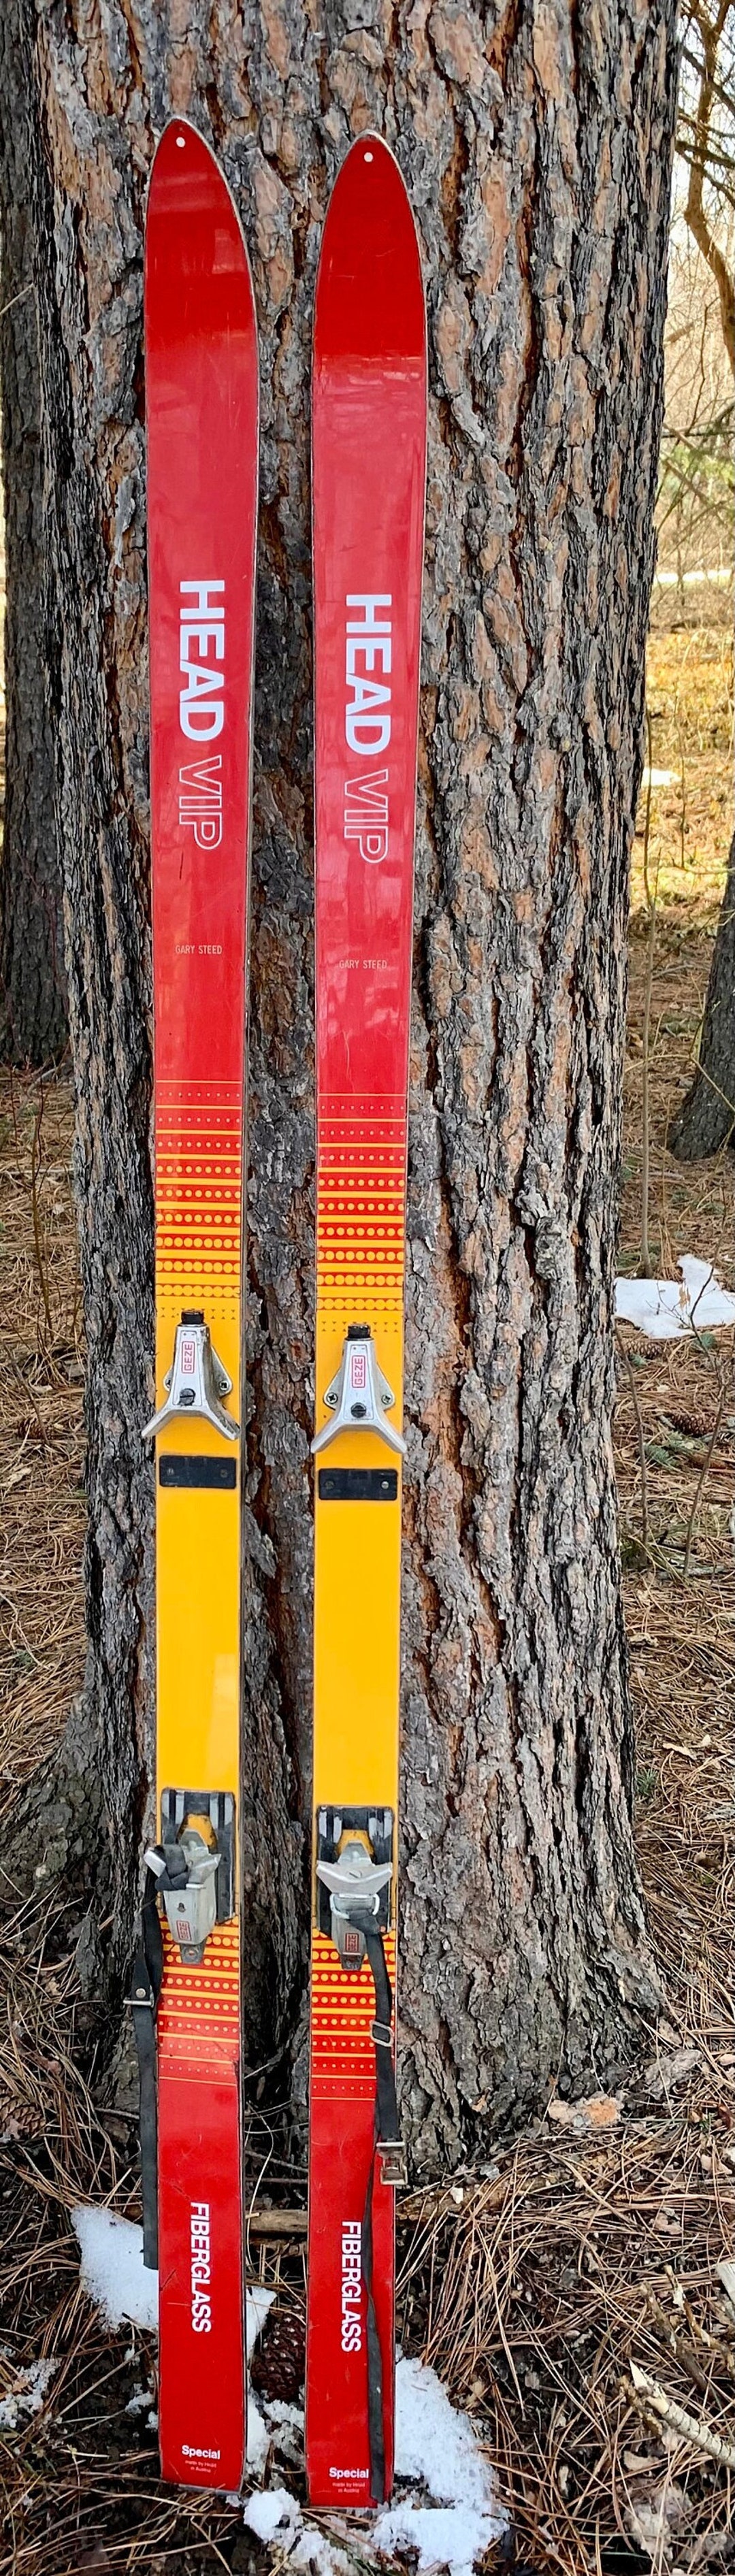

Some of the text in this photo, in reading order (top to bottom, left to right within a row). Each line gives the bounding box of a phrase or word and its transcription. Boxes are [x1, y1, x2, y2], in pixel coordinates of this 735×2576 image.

[178, 580, 225, 851] HEAD VIP
[344, 594, 393, 864] HEAD VIP
[175, 945, 223, 955] GARY STEED
[339, 959, 387, 969] GARY STEED
[184, 1343, 193, 1371] GEZE
[354, 1357, 363, 1386] GEZE
[191, 2202, 212, 2333] FIBERGLASS
[342, 2221, 362, 2353] FIBERGLASS
[181, 2445, 221, 2460] Special
[329, 2466, 369, 2479] Special
